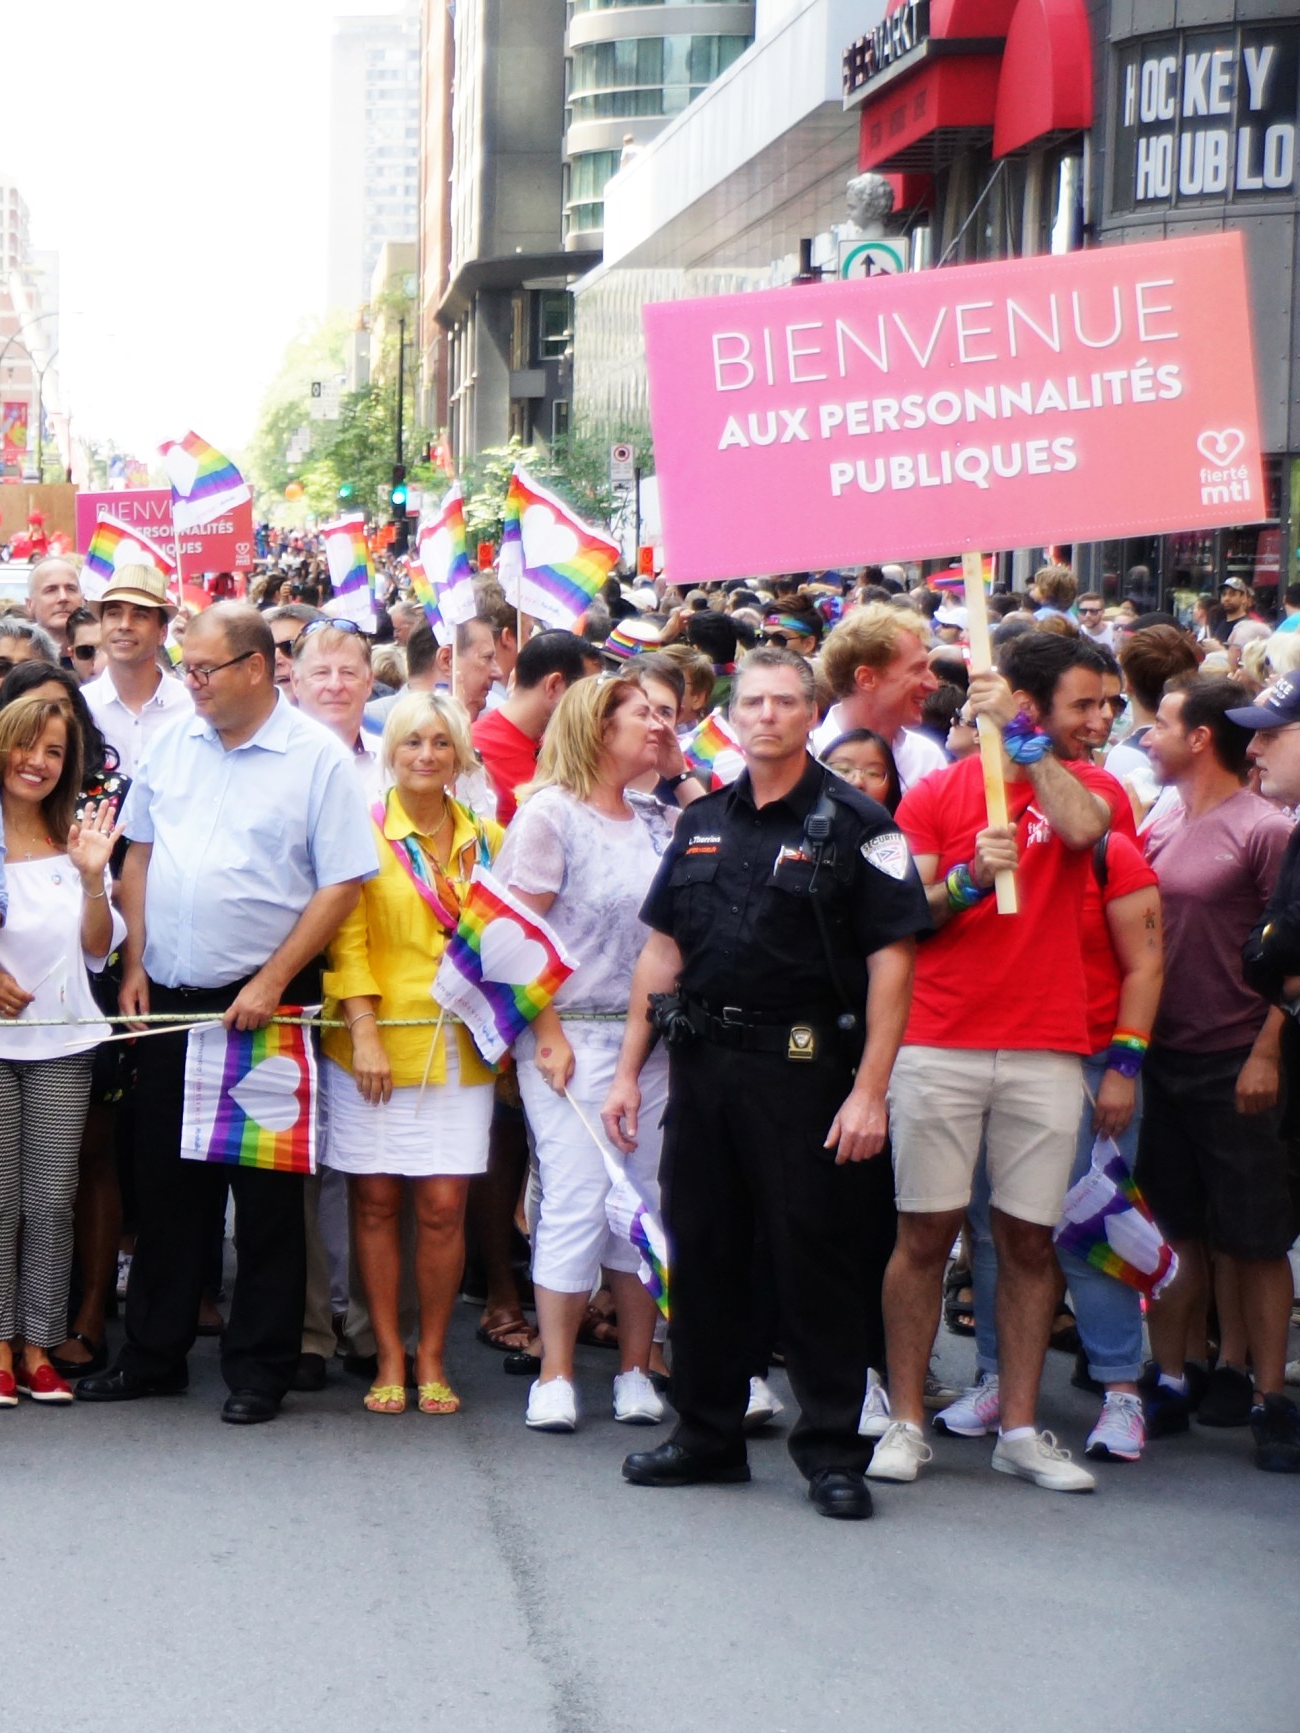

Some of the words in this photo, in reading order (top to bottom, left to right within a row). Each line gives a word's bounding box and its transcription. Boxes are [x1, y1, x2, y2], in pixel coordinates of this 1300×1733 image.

[1124, 46, 1274, 128] HOCKEY
[1136, 124, 1295, 200] HOUBLO
[711, 279, 1179, 392] BIENVENUE
[717, 406, 809, 451] AUX
[818, 357, 1183, 439] PERSONNALITÉS
[830, 436, 1078, 497] PUBLIQUES
[1200, 464, 1248, 484] fierté
[1201, 480, 1250, 506] mtl
